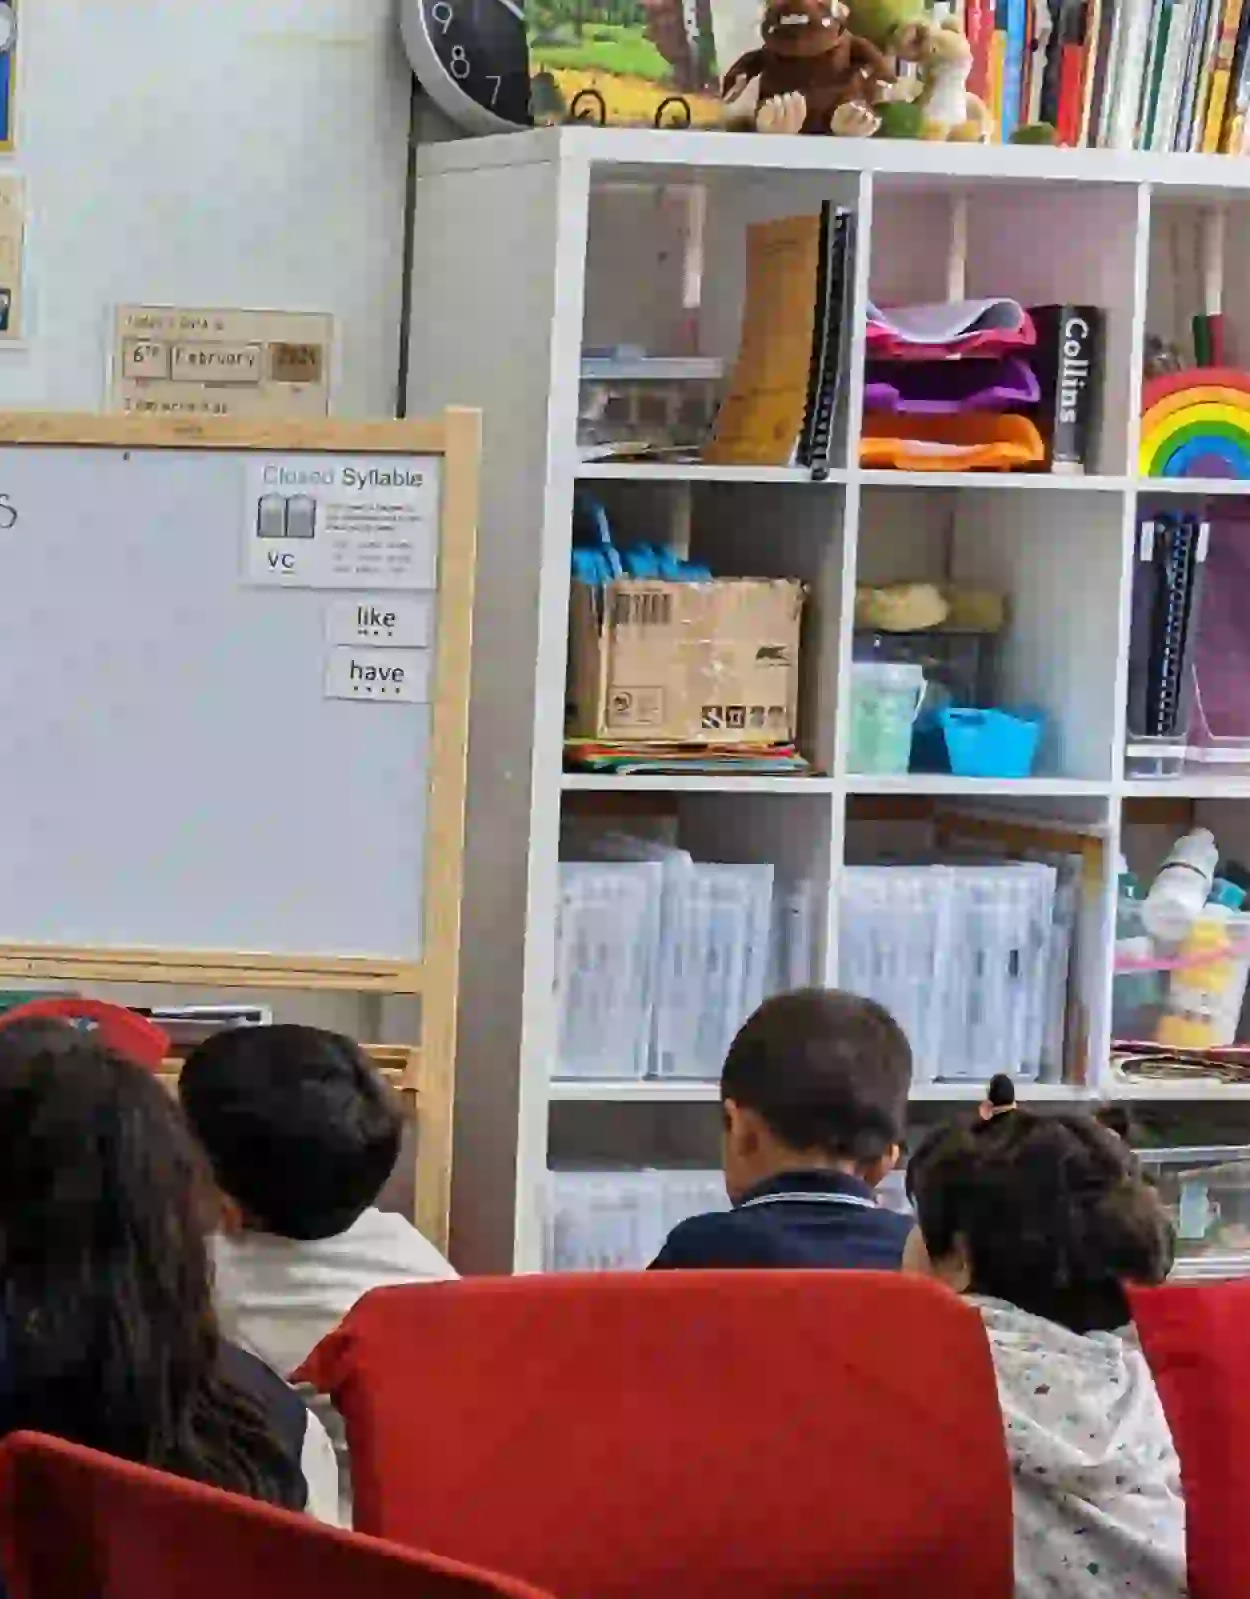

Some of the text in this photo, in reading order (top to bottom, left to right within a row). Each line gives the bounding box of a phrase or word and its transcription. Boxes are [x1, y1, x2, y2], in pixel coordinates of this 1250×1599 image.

[432, 2, 453, 34] 9
[451, 46, 469, 78] 8
[485, 75, 502, 106] 7
[175, 348, 255, 367] February
[1059, 317, 1089, 424] Collins
[263, 465, 424, 490] Closed Syllable
[357, 606, 396, 627] like
[350, 660, 405, 683] have
